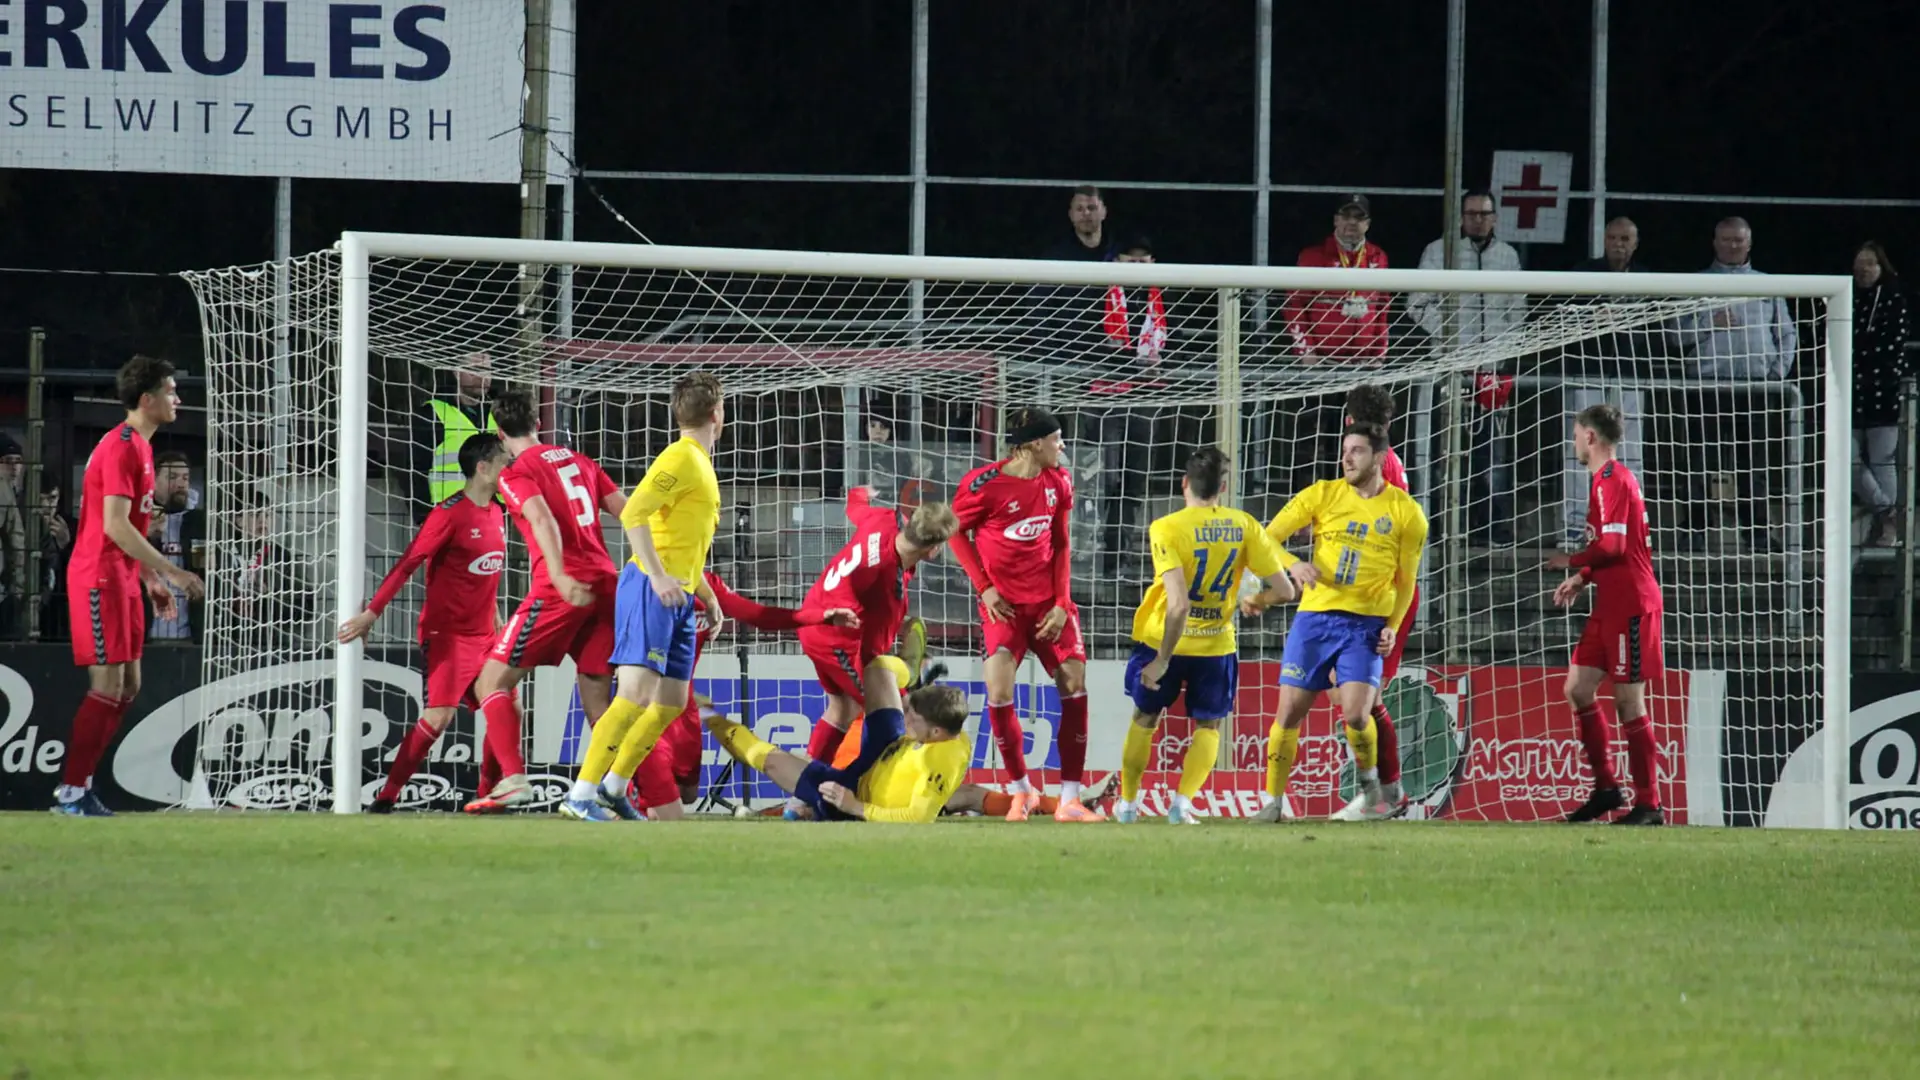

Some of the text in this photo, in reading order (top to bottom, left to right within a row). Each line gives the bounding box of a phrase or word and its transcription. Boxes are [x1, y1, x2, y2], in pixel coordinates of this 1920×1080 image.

[0, 0, 451, 81] RKULES
[9, 94, 452, 141] SELWITZ GMBH
[557, 463, 594, 527] 5
[1194, 527, 1243, 542] LEIPZIG
[823, 543, 862, 591] 3
[1188, 548, 1238, 601] 14
[1464, 737, 1679, 781] AKTIVISTN
[1500, 784, 1572, 801] SINCE
